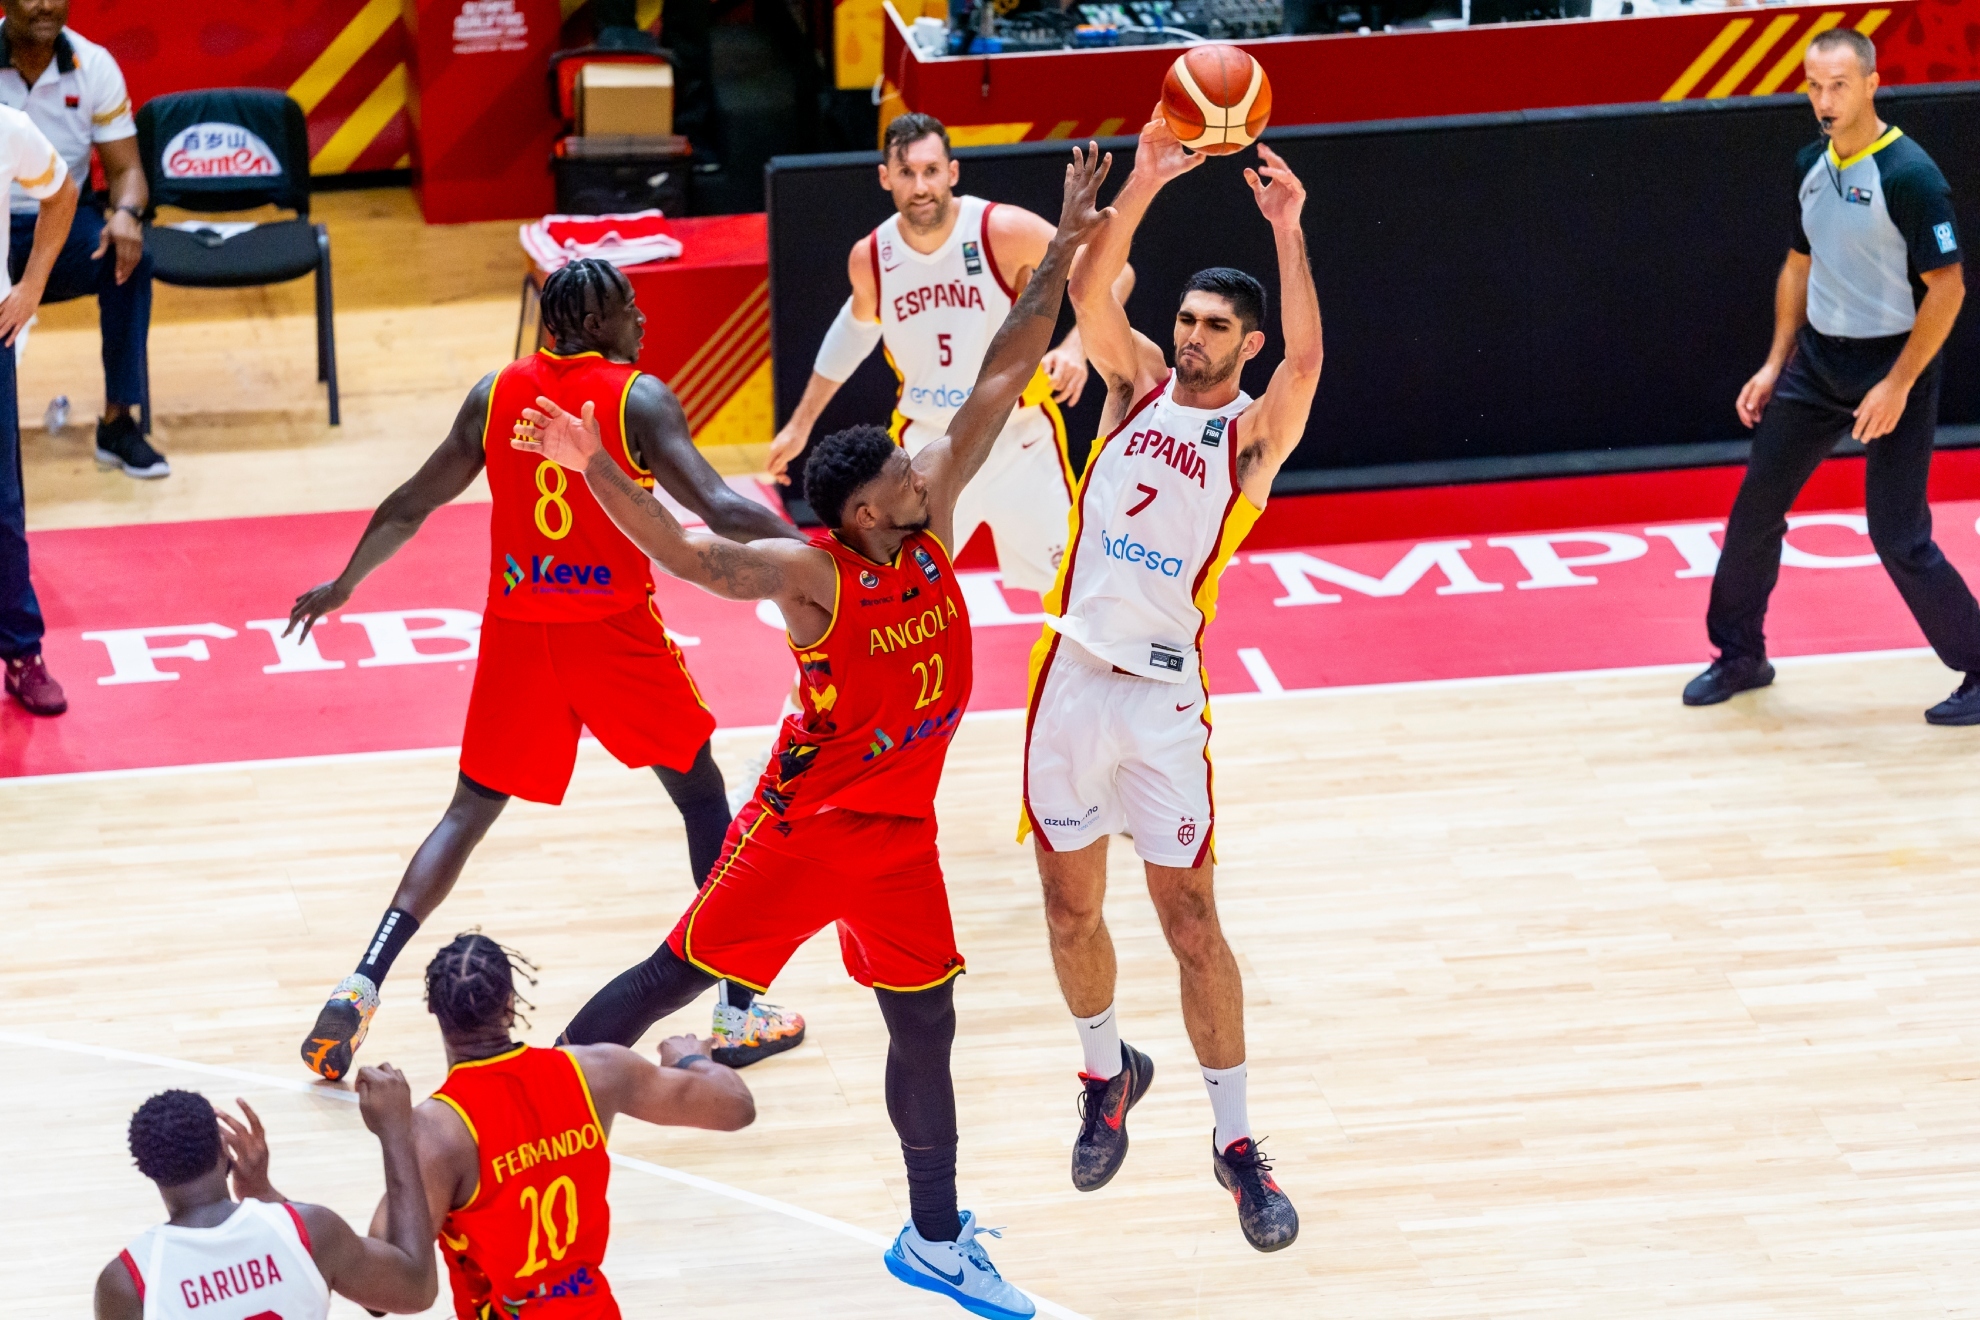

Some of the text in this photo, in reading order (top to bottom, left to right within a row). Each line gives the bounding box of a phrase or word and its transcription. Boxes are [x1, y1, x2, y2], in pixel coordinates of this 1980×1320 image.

[893, 279, 986, 322] ESPAÑA
[937, 333, 953, 367] 5
[1124, 428, 1207, 490] EPAÑA
[533, 459, 573, 541] 8
[1126, 482, 1158, 518] 7
[531, 555, 612, 586] Keve
[82, 606, 701, 687] FIB
[869, 595, 959, 656] ANGOLA
[911, 652, 944, 711] 22
[491, 1123, 599, 1184] FERNANDO
[514, 1175, 579, 1279] 20
[180, 1253, 283, 1309] GARUBA
